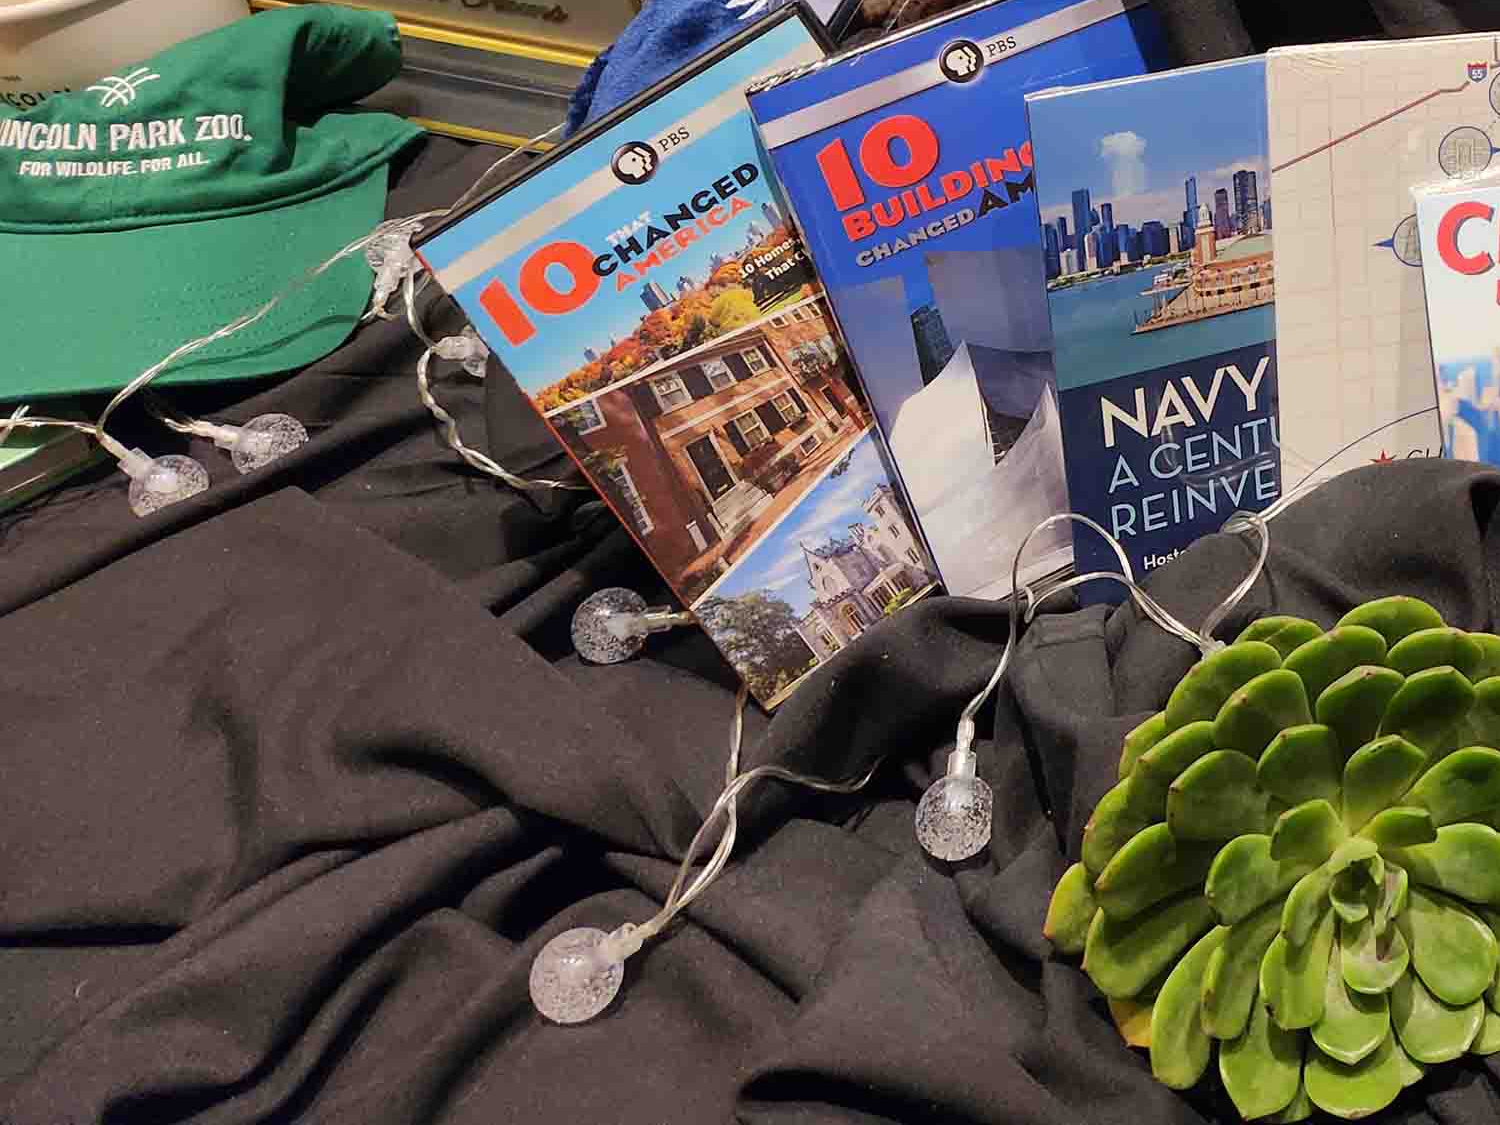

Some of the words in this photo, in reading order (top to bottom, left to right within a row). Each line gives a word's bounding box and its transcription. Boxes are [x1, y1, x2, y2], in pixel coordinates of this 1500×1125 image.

[986, 36, 1017, 58] PBS
[110, 118, 186, 152] PARK
[194, 114, 253, 142] ZOO.
[658, 126, 691, 153] PBS
[19, 161, 51, 177] FOR
[140, 157, 172, 174] FOR
[816, 114, 940, 212] 10
[605, 211, 652, 245] THAT
[615, 196, 754, 292] AMERICA
[855, 209, 976, 268] CHANGED
[479, 241, 601, 348] 10
[591, 161, 760, 278] CHANGED
[738, 263, 754, 279] 10
[765, 258, 796, 280] That
[1100, 356, 1271, 449] NAVY
[1108, 454, 1140, 494] A
